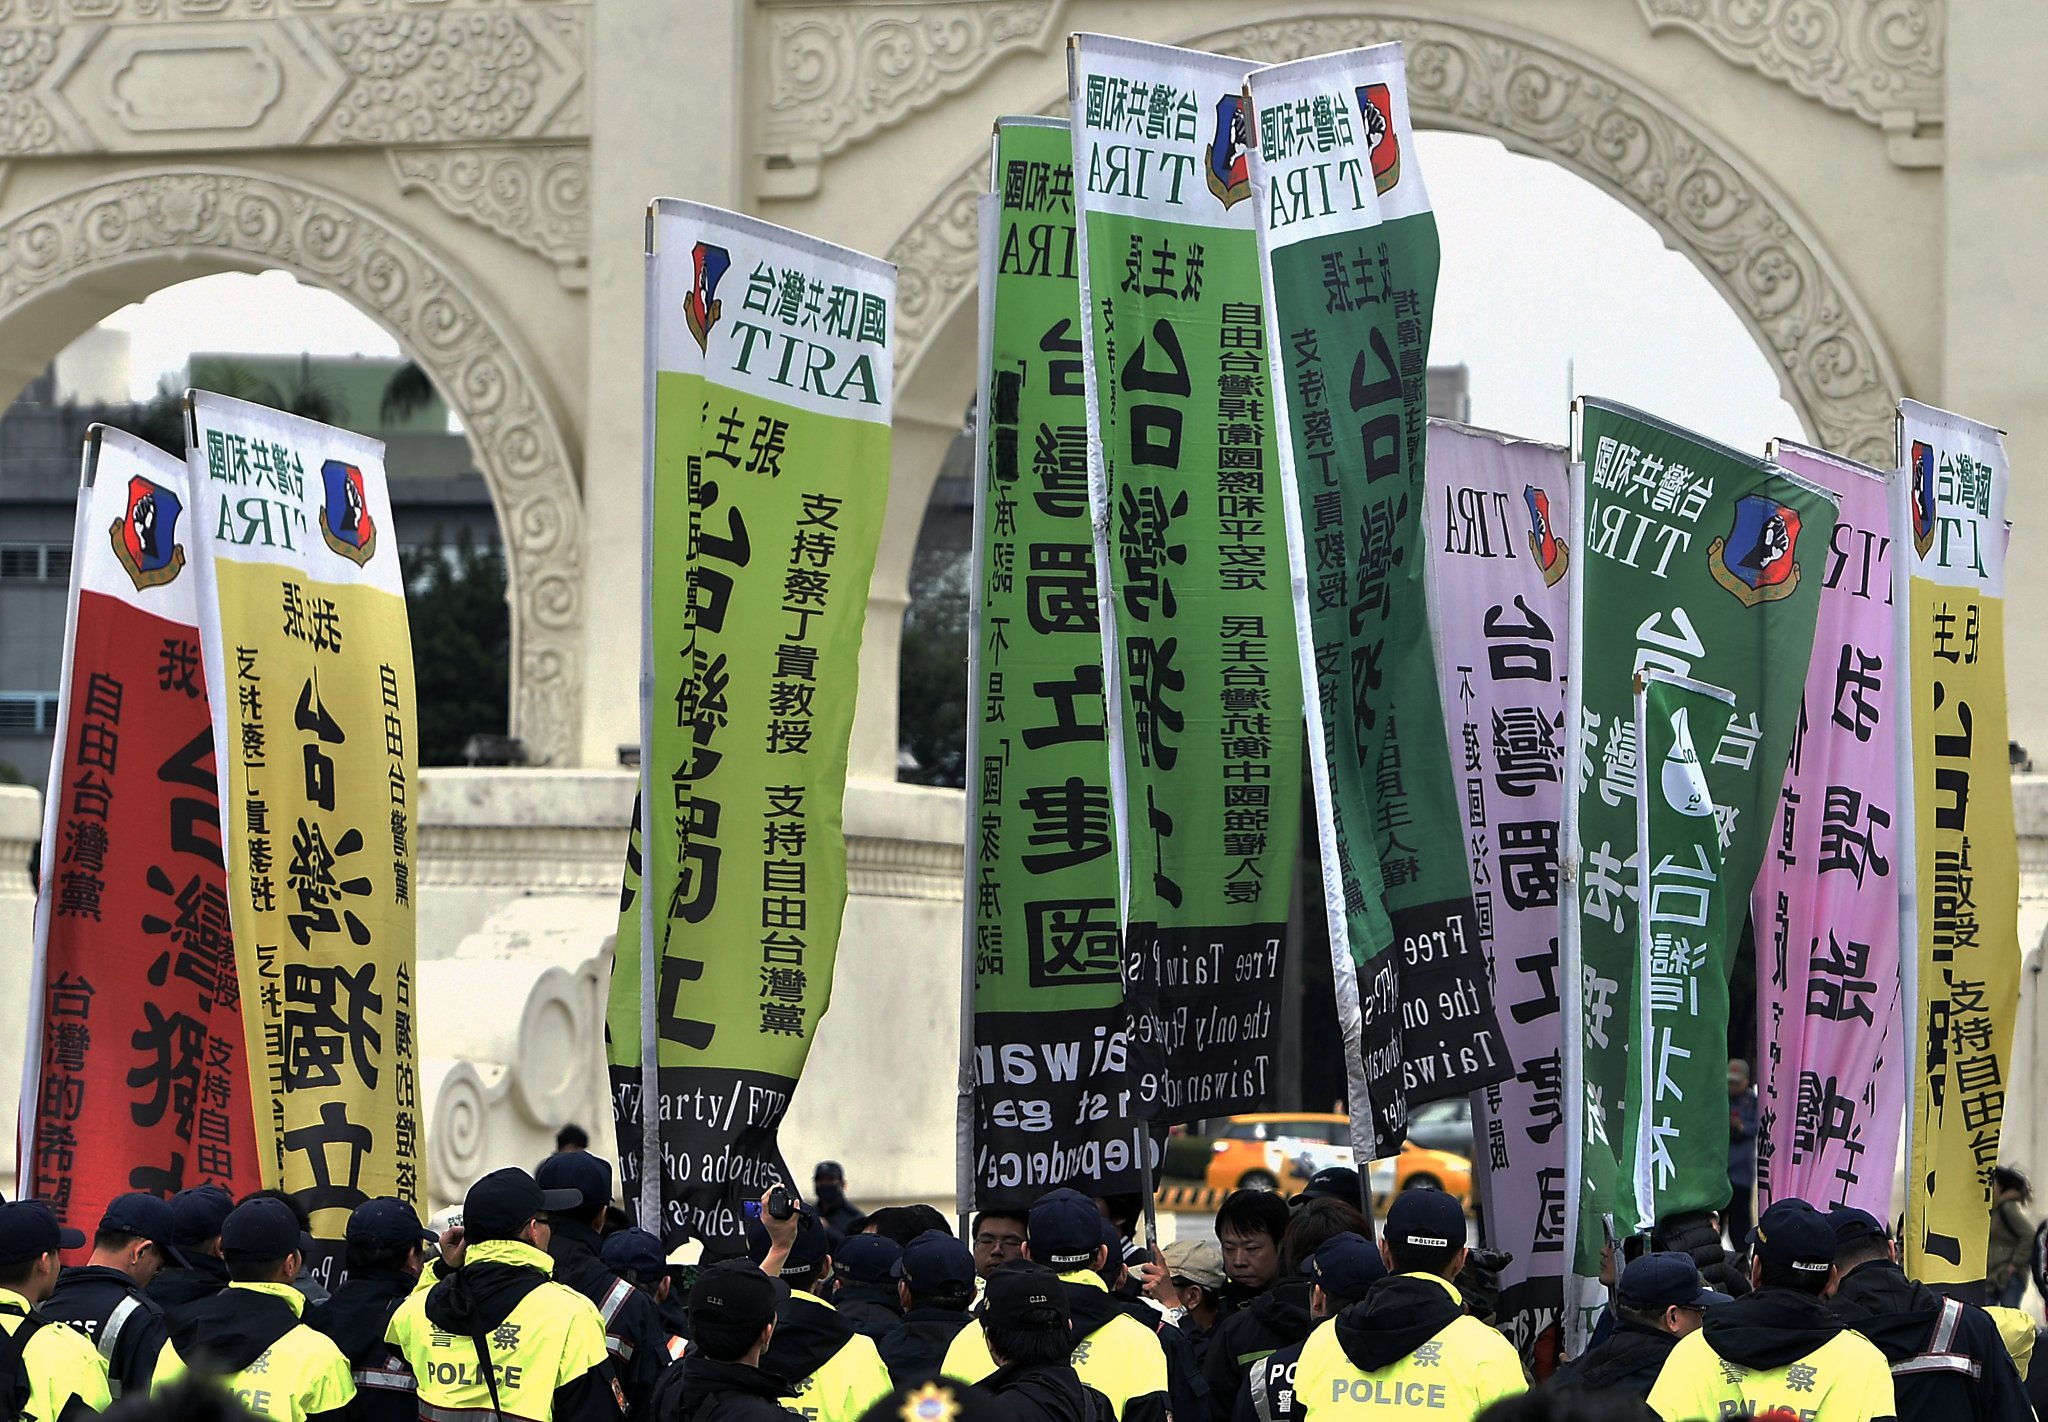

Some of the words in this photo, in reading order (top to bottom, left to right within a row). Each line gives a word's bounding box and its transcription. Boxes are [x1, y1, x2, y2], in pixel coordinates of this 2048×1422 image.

[742, 260, 886, 348] 台灣共和國
[730, 320, 882, 405] TIRA
[702, 406, 790, 478] 主張
[766, 492, 842, 755] 支持蔡丁貴教授
[57, 672, 124, 922] 自由台灣黨
[758, 785, 807, 1039] 支持自由台灣黨
[427, 1361, 522, 1390] POLICE
[1332, 1379, 1445, 1409] POLICE
[1413, 1341, 1443, 1368] 察
